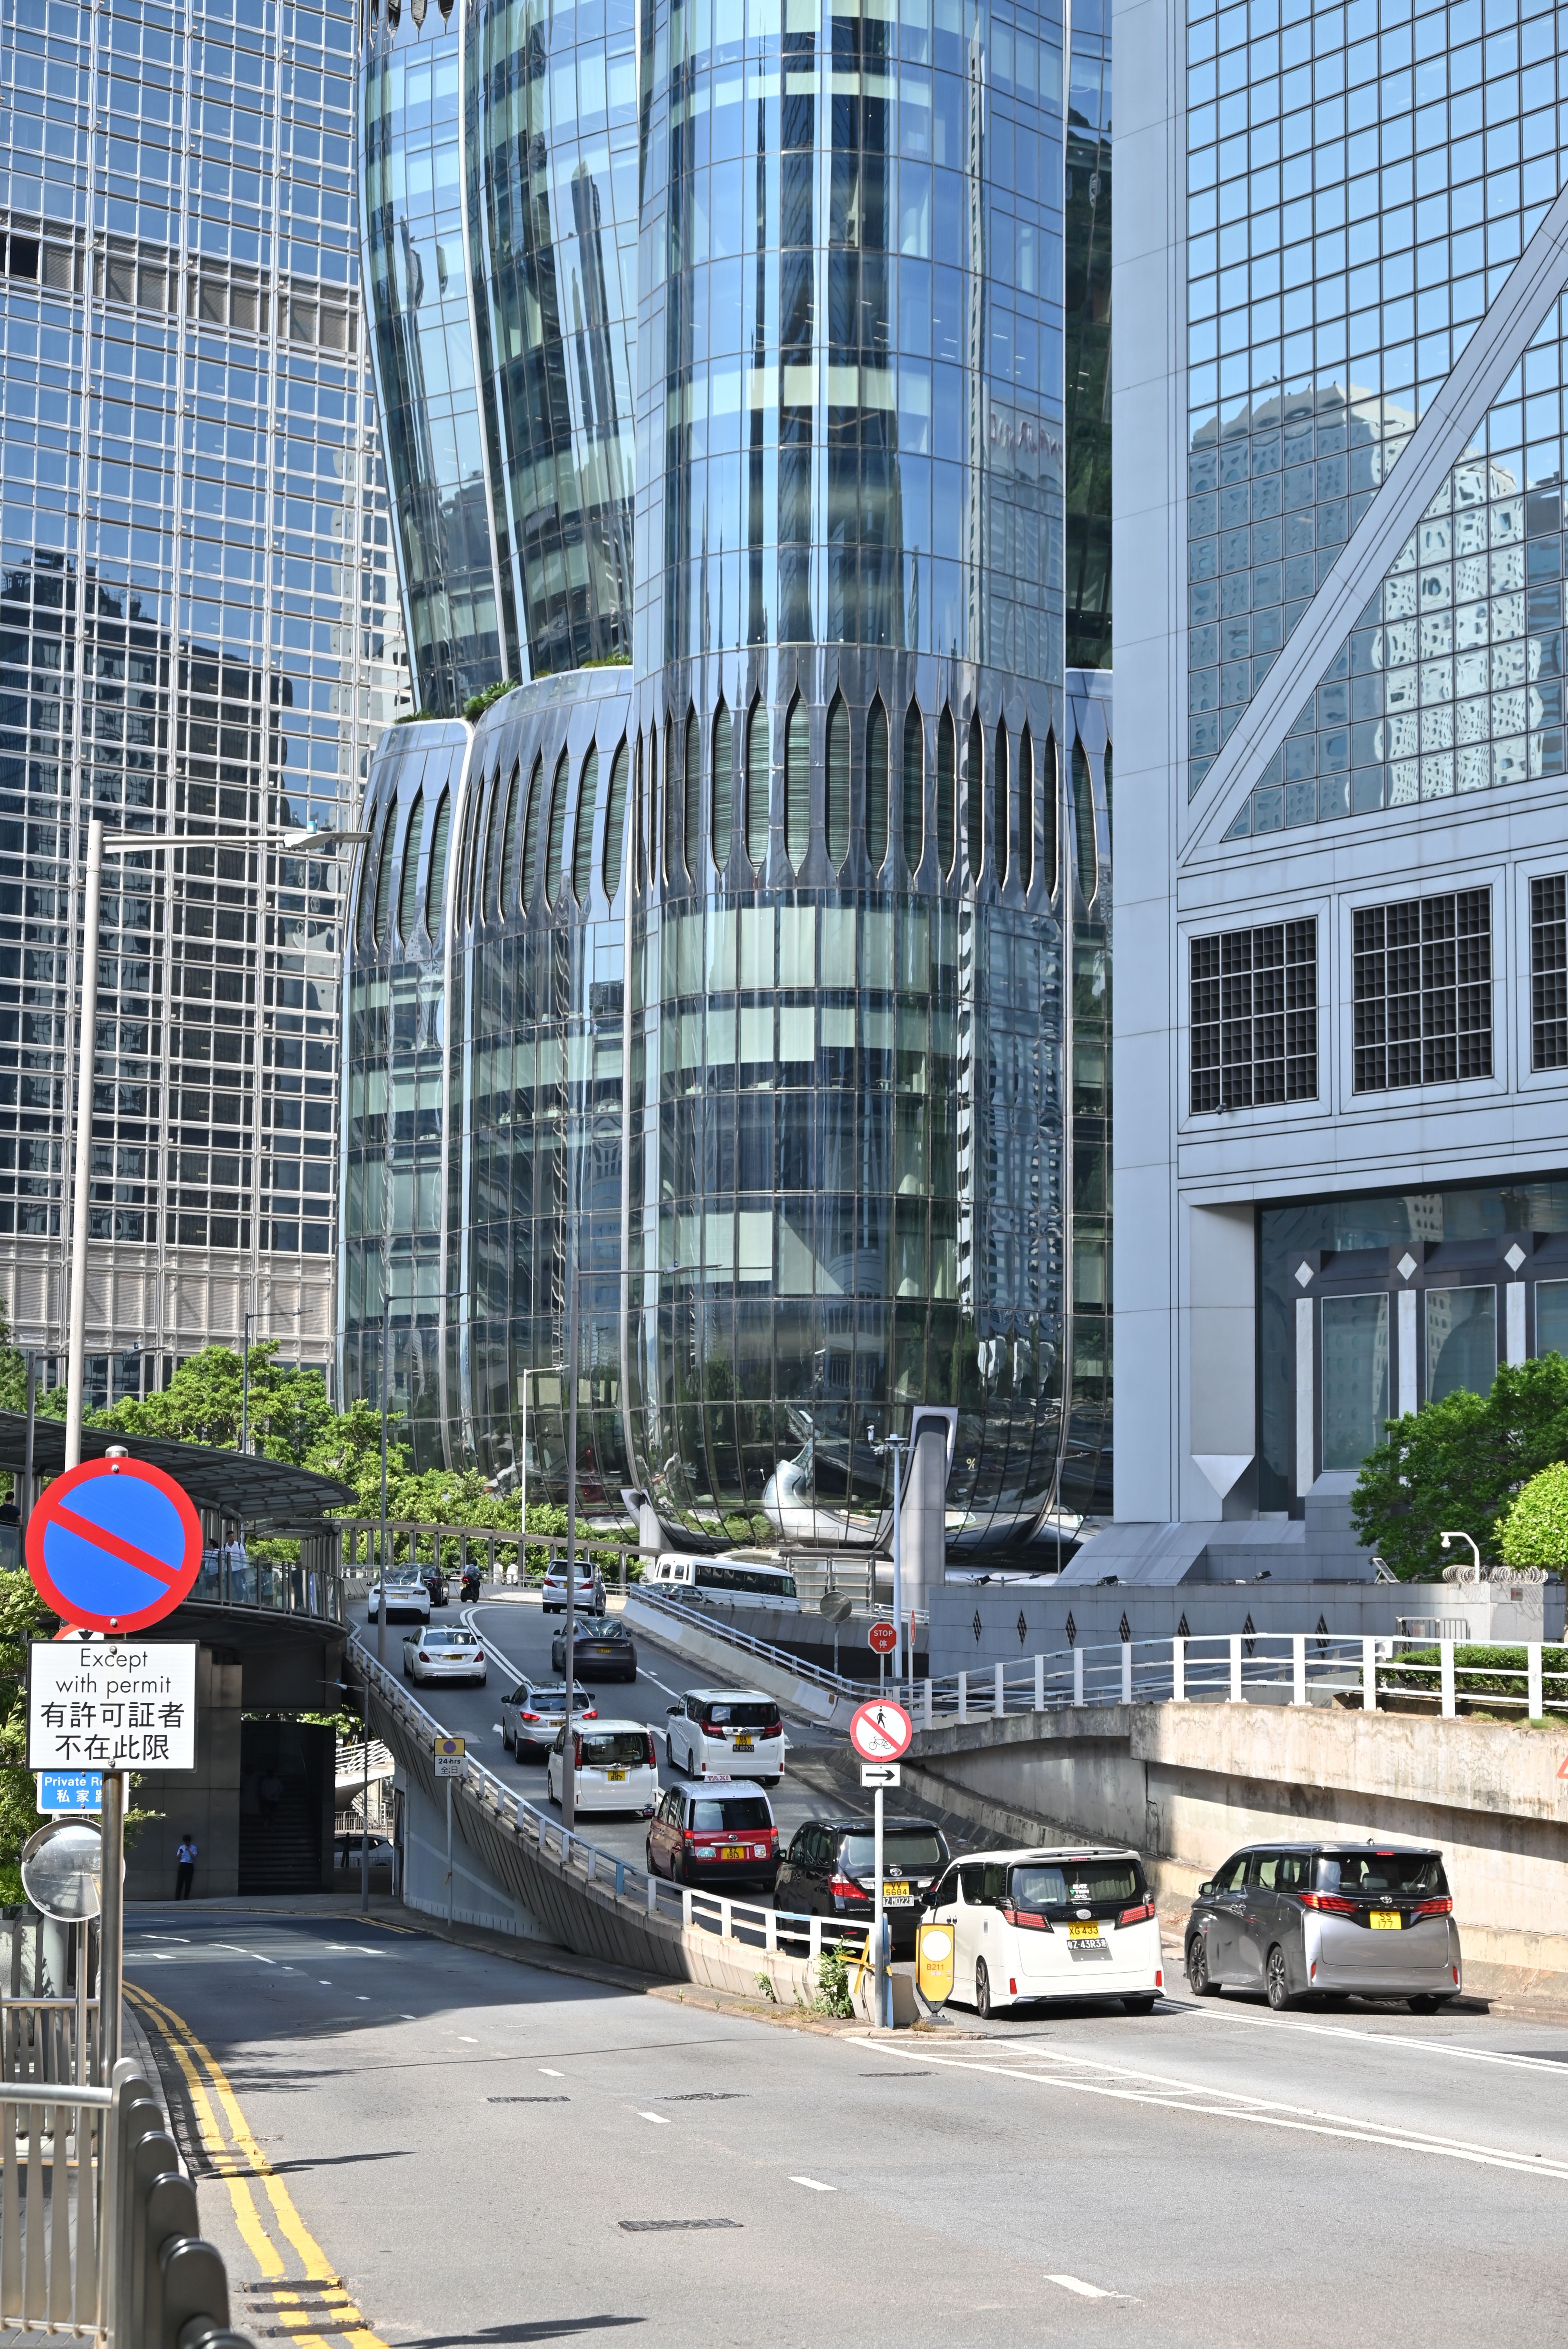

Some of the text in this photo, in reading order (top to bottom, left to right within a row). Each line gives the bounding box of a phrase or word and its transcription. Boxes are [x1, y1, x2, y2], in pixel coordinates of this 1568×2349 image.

[879, 1640, 887, 1648] 停
[81, 1648, 148, 1673] Except
[56, 1673, 171, 1699] with permit
[41, 1701, 184, 1728] 有許可証者
[55, 1734, 169, 1761] 不在此限
[45, 1777, 86, 1786] Private
